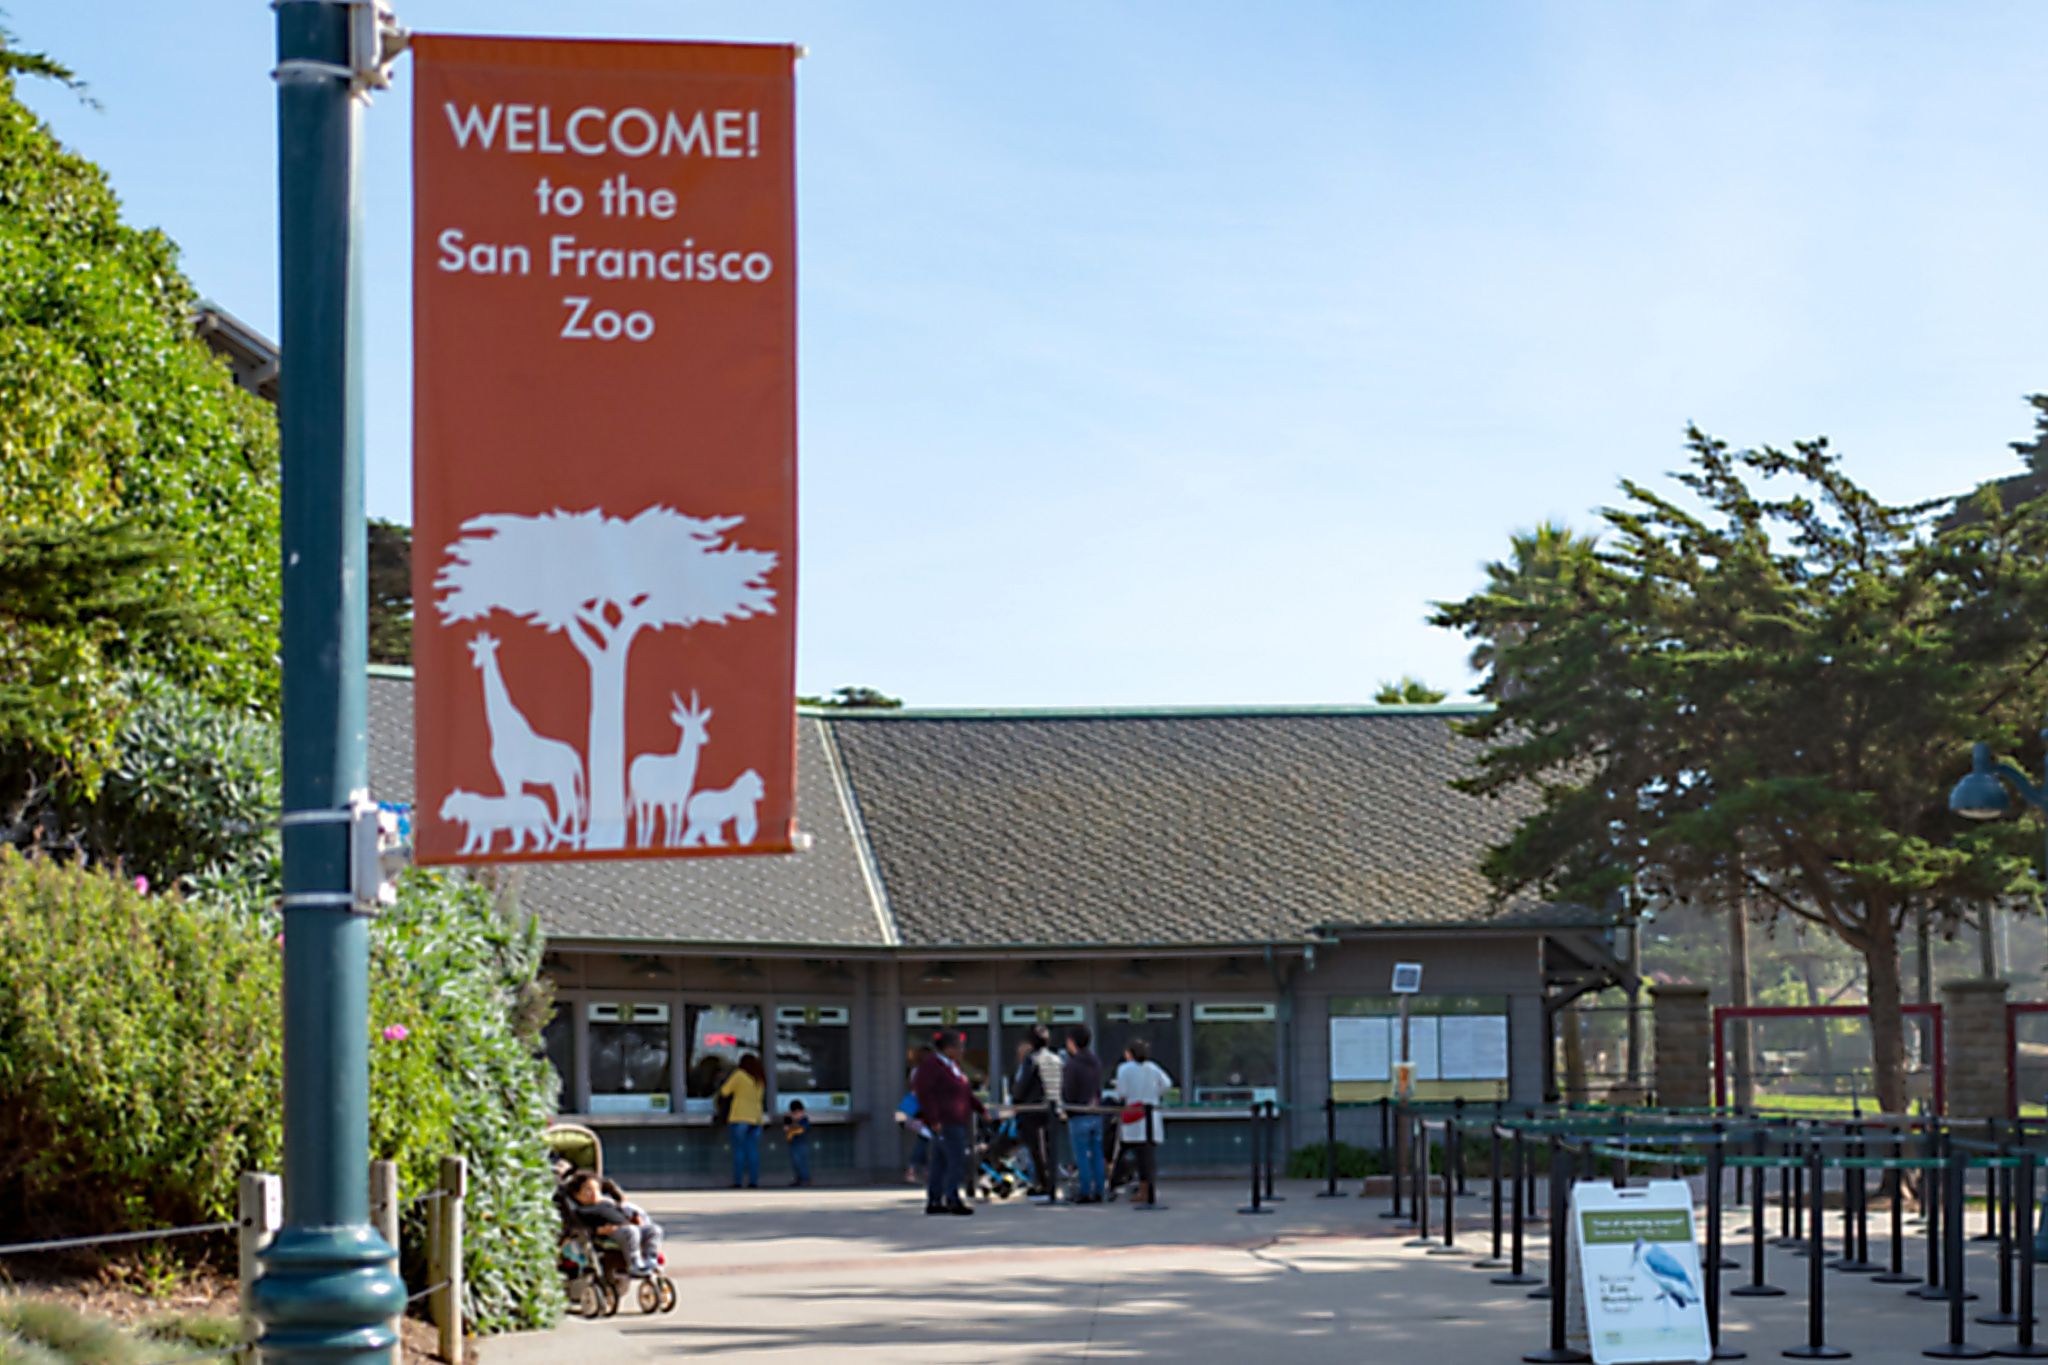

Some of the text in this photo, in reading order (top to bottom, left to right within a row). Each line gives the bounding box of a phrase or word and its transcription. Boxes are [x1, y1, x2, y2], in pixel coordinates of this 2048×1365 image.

[445, 102, 758, 158] WELCOME!
[536, 173, 677, 219] to the
[438, 229, 772, 282] San Francisco
[560, 296, 655, 341] Zoo
